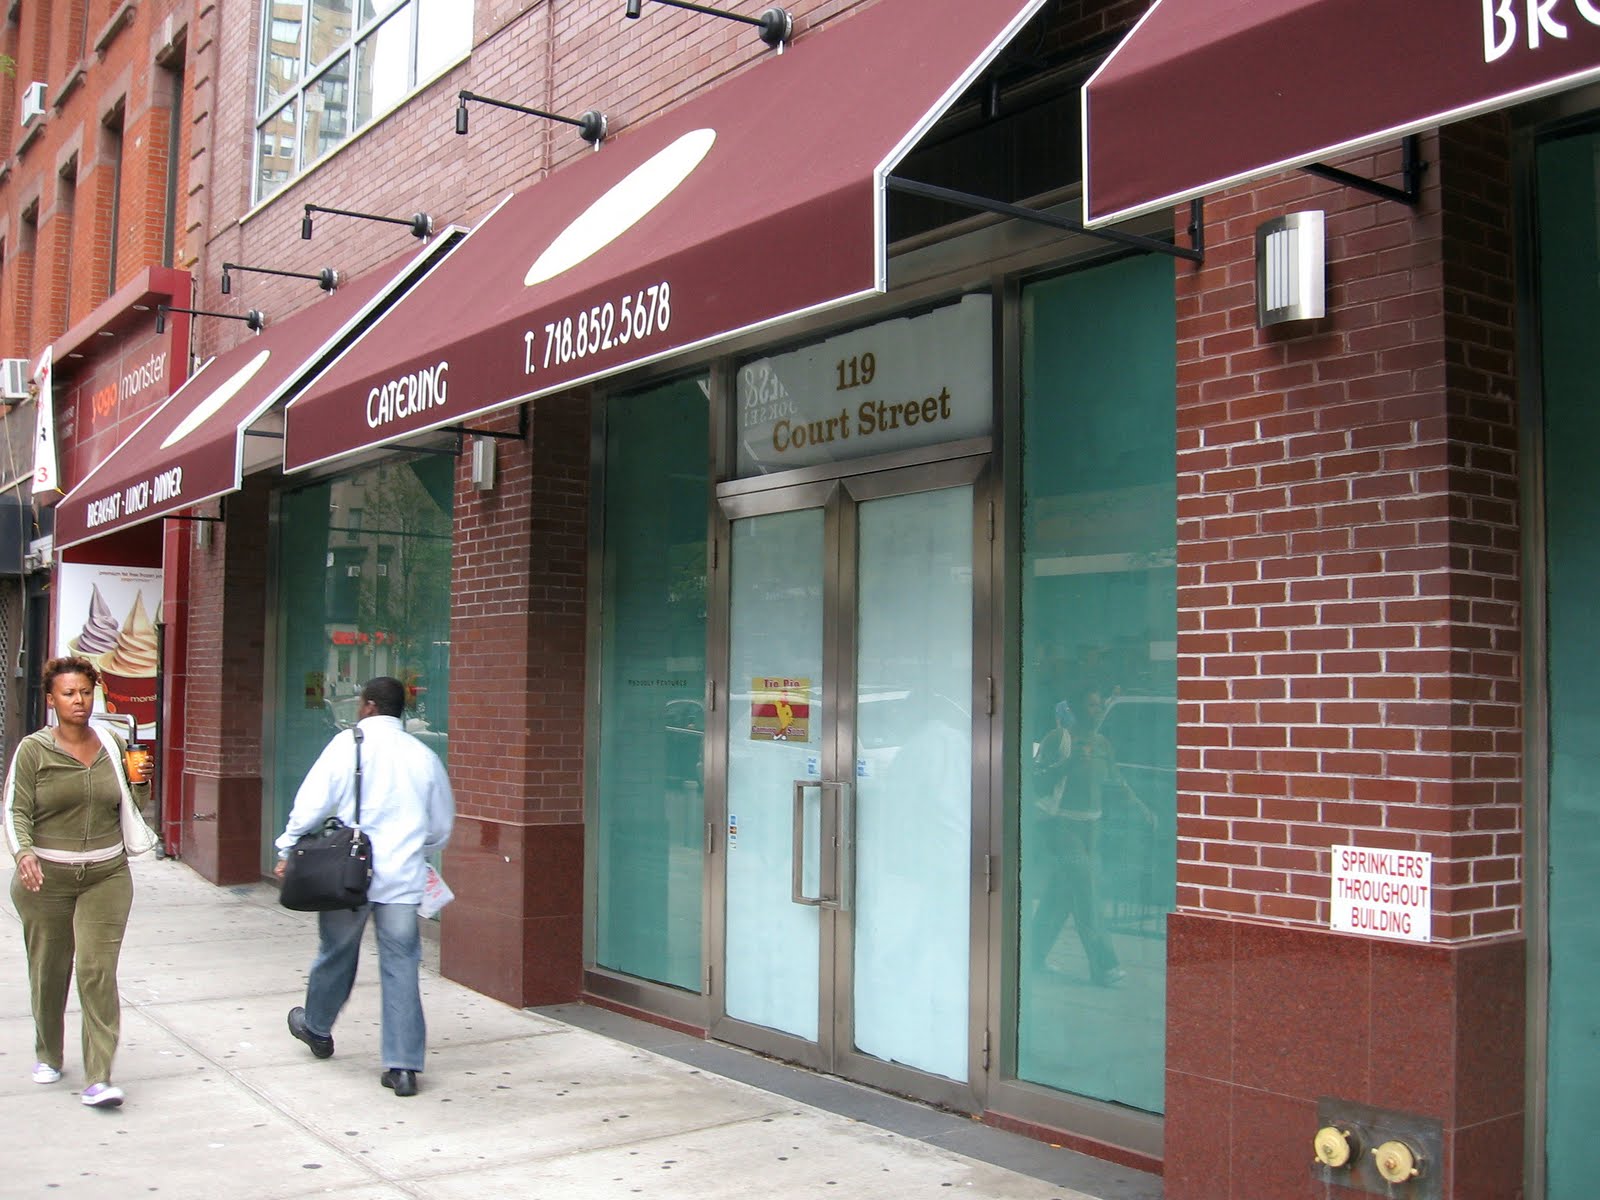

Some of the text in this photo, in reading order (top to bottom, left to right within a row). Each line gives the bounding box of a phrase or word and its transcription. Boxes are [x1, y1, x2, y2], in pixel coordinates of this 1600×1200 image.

[1481, 0, 1600, 64] BR
[542, 281, 671, 369] 718.852.5678
[91, 382, 118, 424] yogo
[121, 351, 167, 401] monster
[366, 360, 449, 428] CATERING
[836, 352, 876, 391] 119
[772, 407, 850, 453] Court
[858, 386, 951, 436] Street
[38, 467, 49, 483] 3
[86, 466, 183, 528] BREAKFAST LUNCH DINNER
[1337, 877, 1428, 908] THROUGHOUT
[1341, 850, 1423, 879] SPRINKLERS
[1351, 906, 1412, 934] BUILDING
